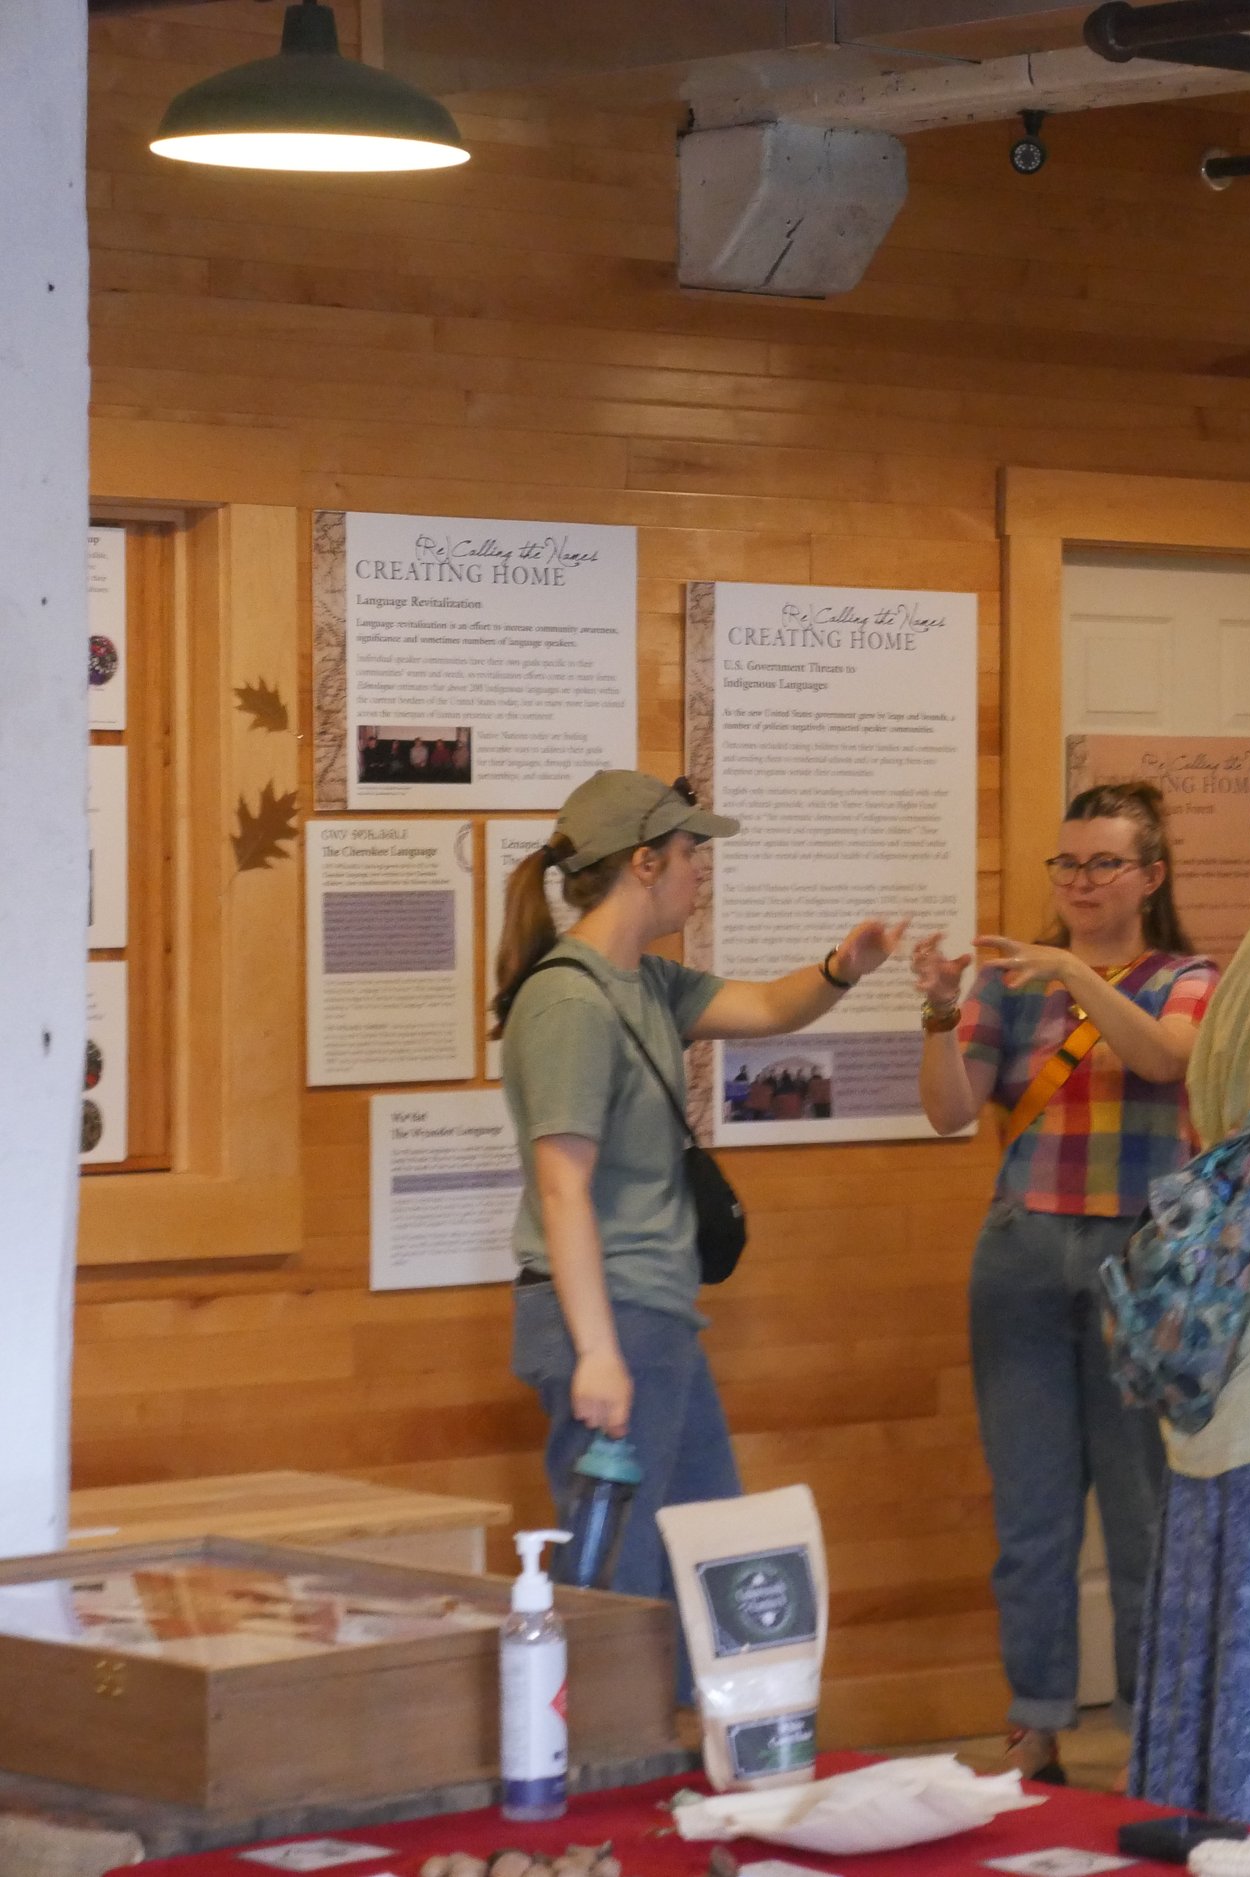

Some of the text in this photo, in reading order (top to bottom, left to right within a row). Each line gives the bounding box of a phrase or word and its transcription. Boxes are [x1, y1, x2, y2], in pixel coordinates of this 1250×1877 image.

[518, 541, 545, 560] the
[544, 535, 600, 567] Names
[355, 559, 566, 586] CREATING HOME
[356, 594, 482, 609] Language Revitalization
[874, 606, 895, 625] the
[356, 618, 394, 630] Language
[398, 620, 447, 630] revitalization
[535, 625, 578, 635] community
[404, 635, 417, 643] and
[420, 636, 460, 645] sometimes
[462, 637, 497, 646] numbers
[509, 638, 542, 649] language
[727, 626, 917, 651] CREATING HOME
[723, 660, 856, 673] U.S. Government Threats to
[723, 677, 829, 692] Indigenous Languages
[815, 711, 856, 721] government
[321, 846, 437, 860] The Cherokee Language
